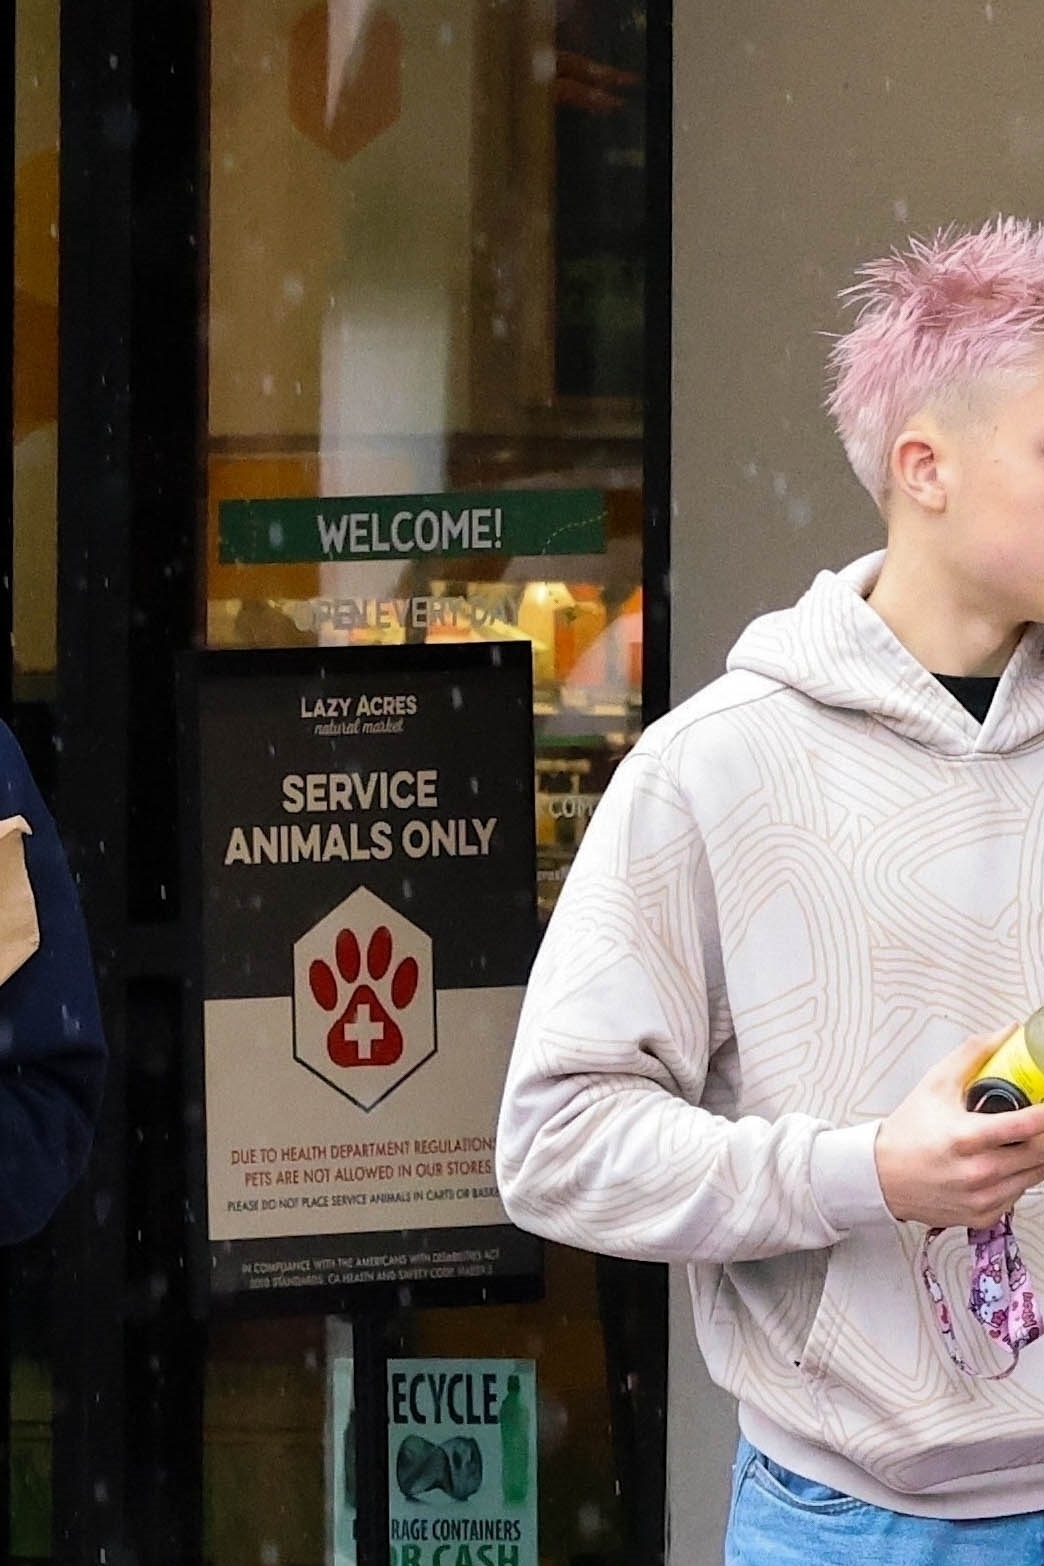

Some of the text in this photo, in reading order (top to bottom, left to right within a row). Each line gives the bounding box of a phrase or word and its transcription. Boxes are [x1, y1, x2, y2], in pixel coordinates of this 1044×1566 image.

[317, 509, 502, 553] WELCOME!
[375, 597, 467, 629] EVERY
[301, 694, 417, 718] LAZY ACRES
[314, 717, 404, 735] natural market
[282, 770, 438, 813] SERVICE
[224, 817, 498, 865] ANIMALS ONLY
[231, 1149, 256, 1165] DUE
[260, 1147, 277, 1163] TO
[282, 1145, 326, 1161] HEALTH
[331, 1141, 409, 1159] DEPARTMENT
[245, 1160, 491, 1187] PETS ARE NOT ALLOWED IN OUR STORES
[227, 1199, 258, 1212] PLEASE
[262, 1199, 275, 1210] DO
[279, 1197, 298, 1209] NOT
[302, 1196, 328, 1208] PLACE
[331, 1194, 366, 1206] SERVICE
[370, 1191, 411, 1203] ANIMALS
[413, 1190, 424, 1200] IN
[426, 1188, 455, 1201] CARTS
[456, 1187, 469, 1199] OR
[356, 1255, 407, 1267] AMERICANS
[392, 1373, 498, 1424] ECYCLE
[433, 1519, 521, 1542] CONTAINERS
